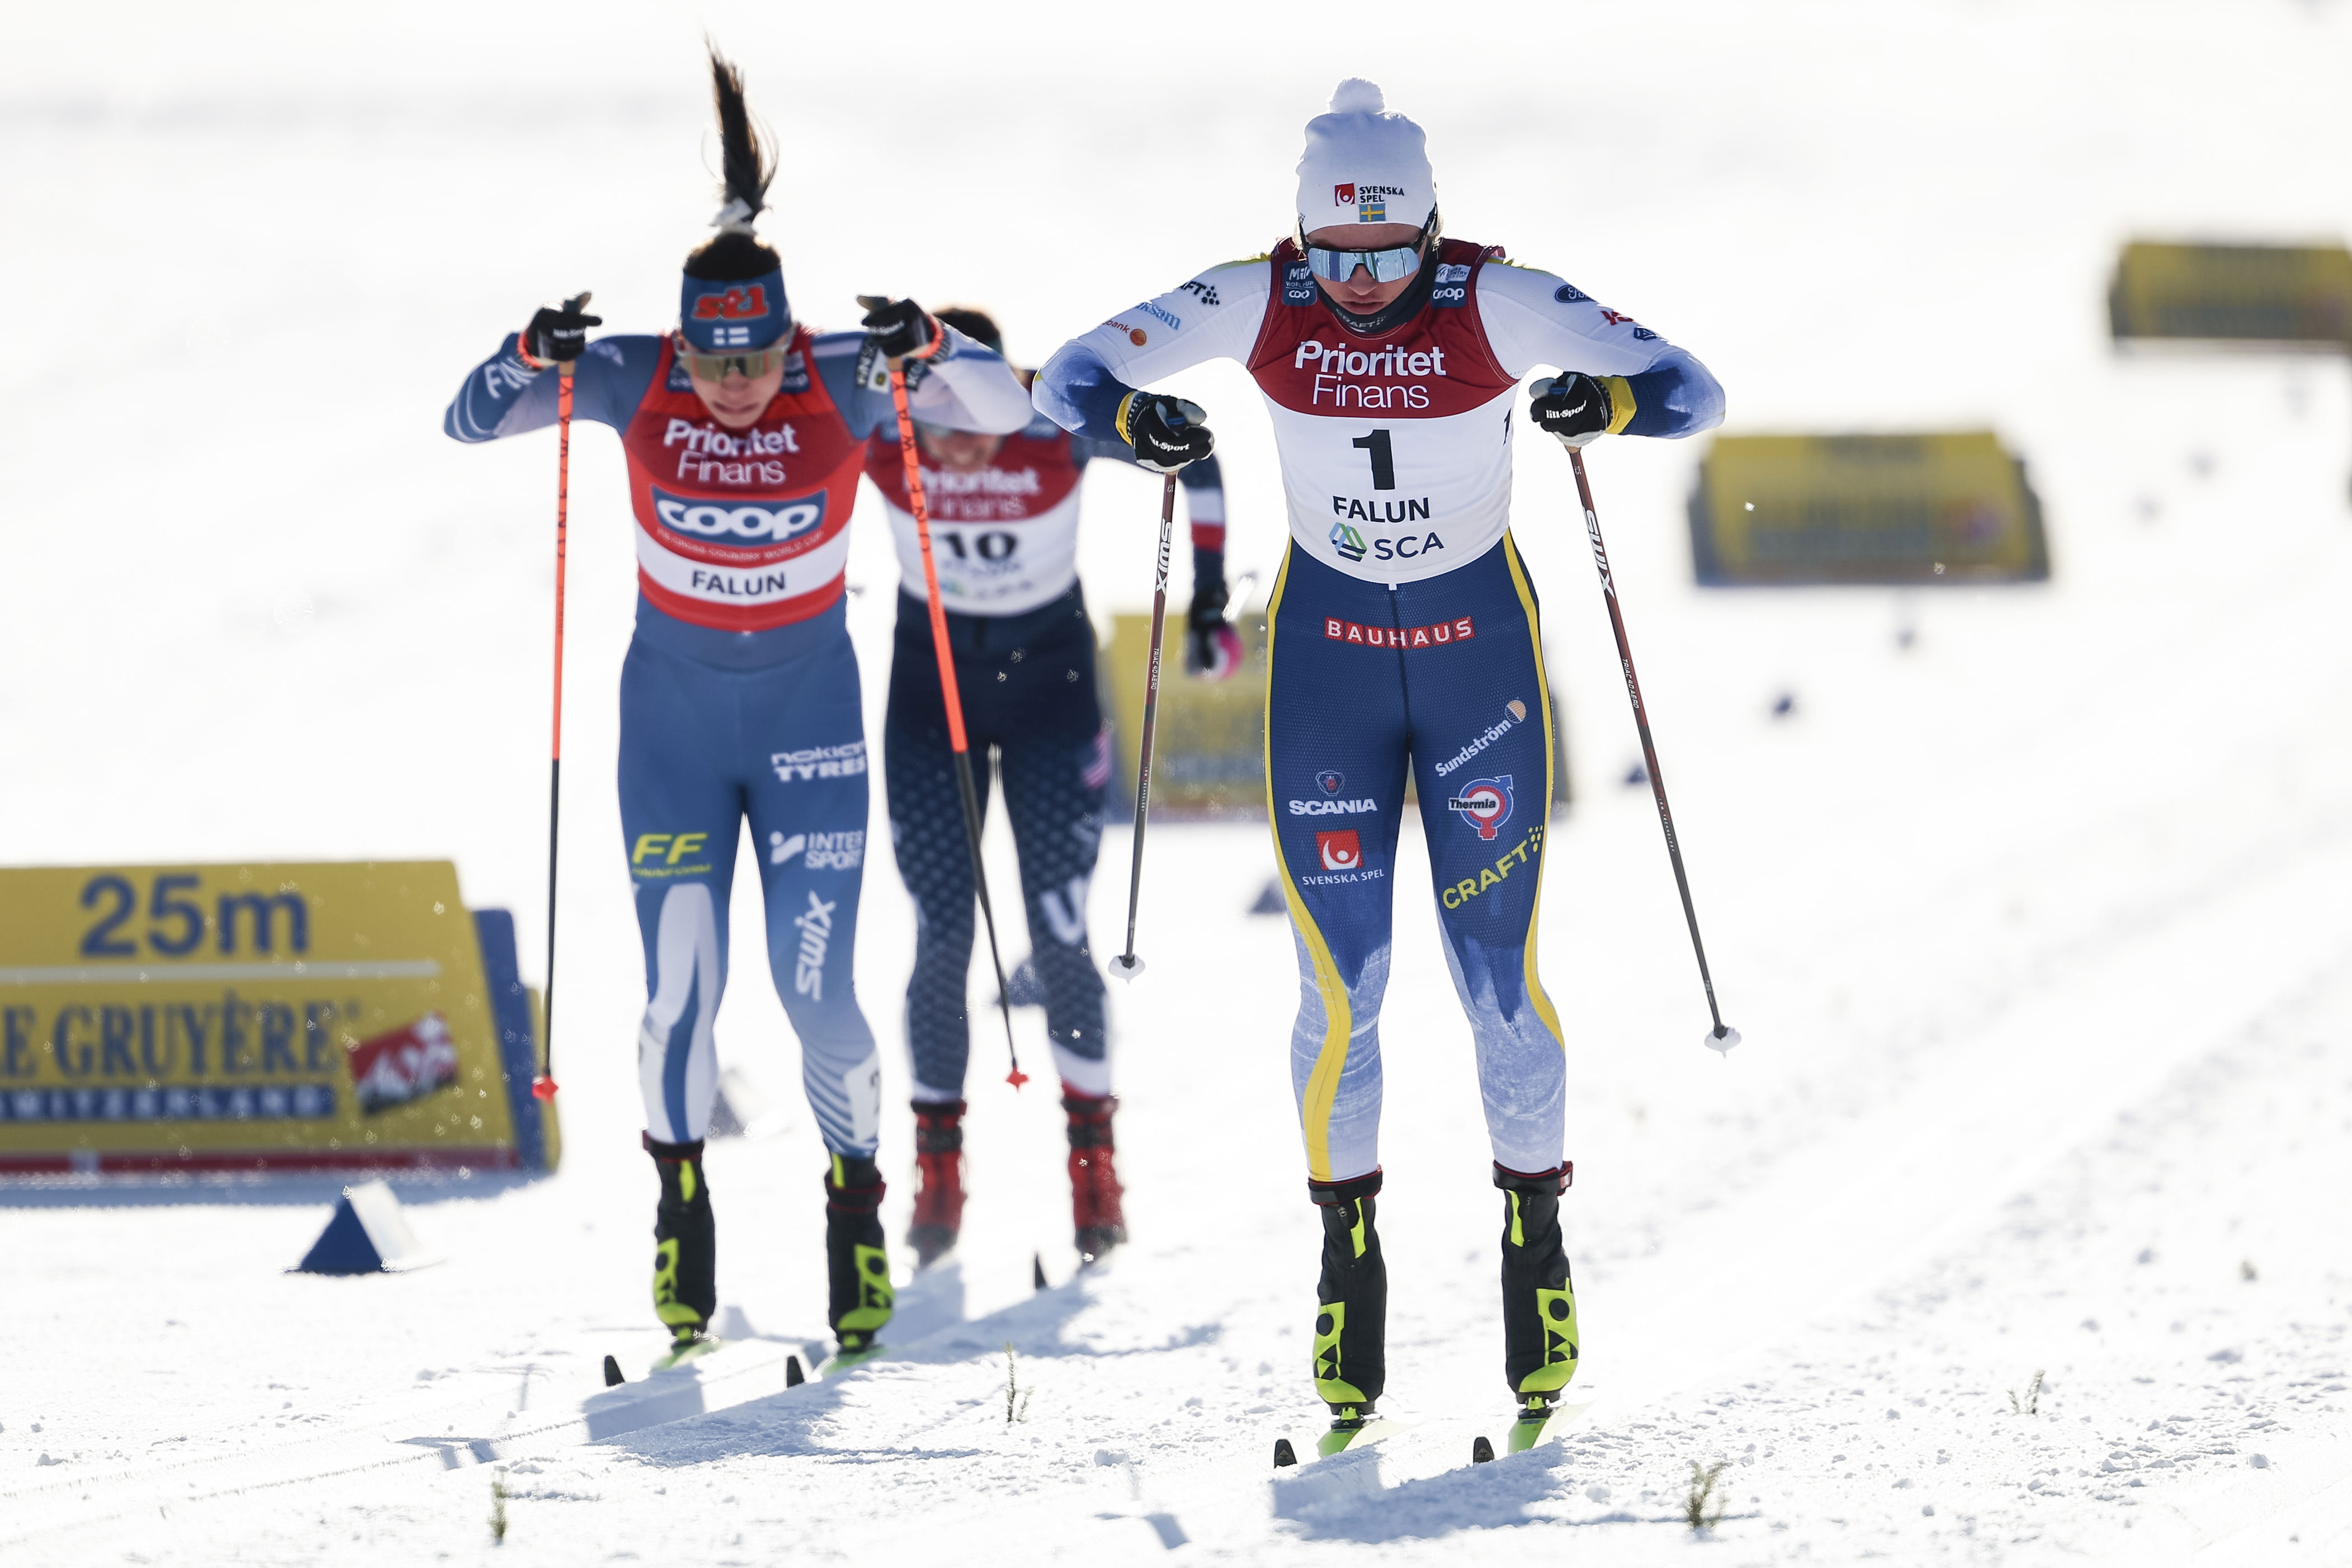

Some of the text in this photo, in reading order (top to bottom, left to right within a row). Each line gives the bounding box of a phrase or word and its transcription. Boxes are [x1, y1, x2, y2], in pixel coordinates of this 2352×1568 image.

[1359, 186, 1405, 196] SVENSKA
[1360, 195, 1385, 203] SPEL
[1433, 288, 1465, 301] coop
[1295, 340, 1446, 376] Prioritet
[1312, 374, 1430, 409] Finans
[677, 449, 786, 485] Finans
[1352, 429, 1396, 490] 1
[657, 499, 819, 541] coop
[1333, 495, 1430, 523] FALUN
[936, 531, 1019, 561] 10
[1375, 532, 1444, 560] SCA
[692, 569, 785, 595] FALUN
[1328, 620, 1472, 646] BAUHAUS
[1622, 658, 1632, 678] TRIAC
[1435, 719, 1512, 777] Sundström
[1289, 799, 1378, 815] SCANIA
[1449, 798, 1496, 809] Thermia
[631, 832, 709, 865] FF
[1302, 868, 1385, 885] SVENSKA SPEL
[1443, 839, 1528, 909] CRAFT
[79, 872, 311, 958] 25m
[2, 1005, 37, 1078] E
